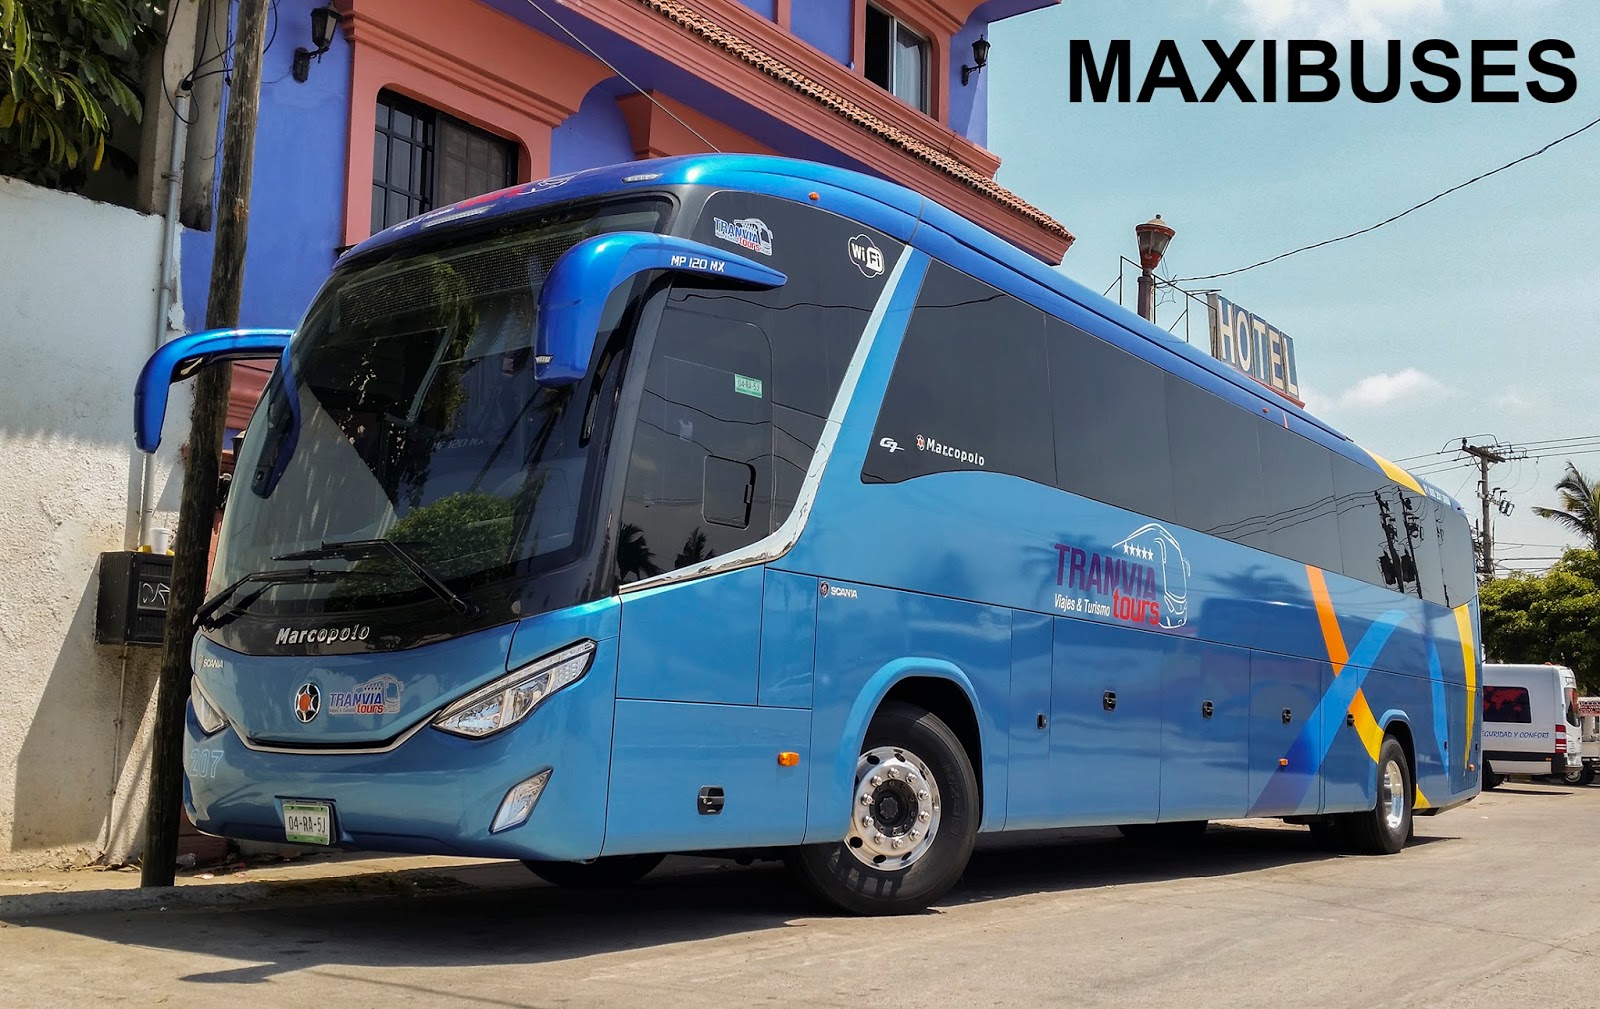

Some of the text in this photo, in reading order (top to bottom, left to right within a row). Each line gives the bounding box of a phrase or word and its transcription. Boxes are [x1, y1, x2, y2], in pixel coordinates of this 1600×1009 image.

[715, 219, 760, 244] TRANVIA
[739, 237, 761, 252] tours
[671, 255, 726, 272] MP 120 MX
[1217, 299, 1299, 396] HOTEL
[927, 437, 985, 466] Marcopolo
[1054, 543, 1156, 601] TRANVIA
[830, 586, 858, 599] SCANIA
[1054, 589, 1160, 625] Viajes & Turismo tours
[275, 624, 370, 646] Marcopolo
[203, 658, 225, 669] SCANIA
[329, 692, 383, 707] TRANVIA
[356, 702, 384, 714] tours
[1481, 730, 1513, 738] EGURIDAD
[1519, 731, 1550, 739] CONFORT
[188, 748, 225, 779] 207
[288, 815, 327, 834] 04-RA-5J
